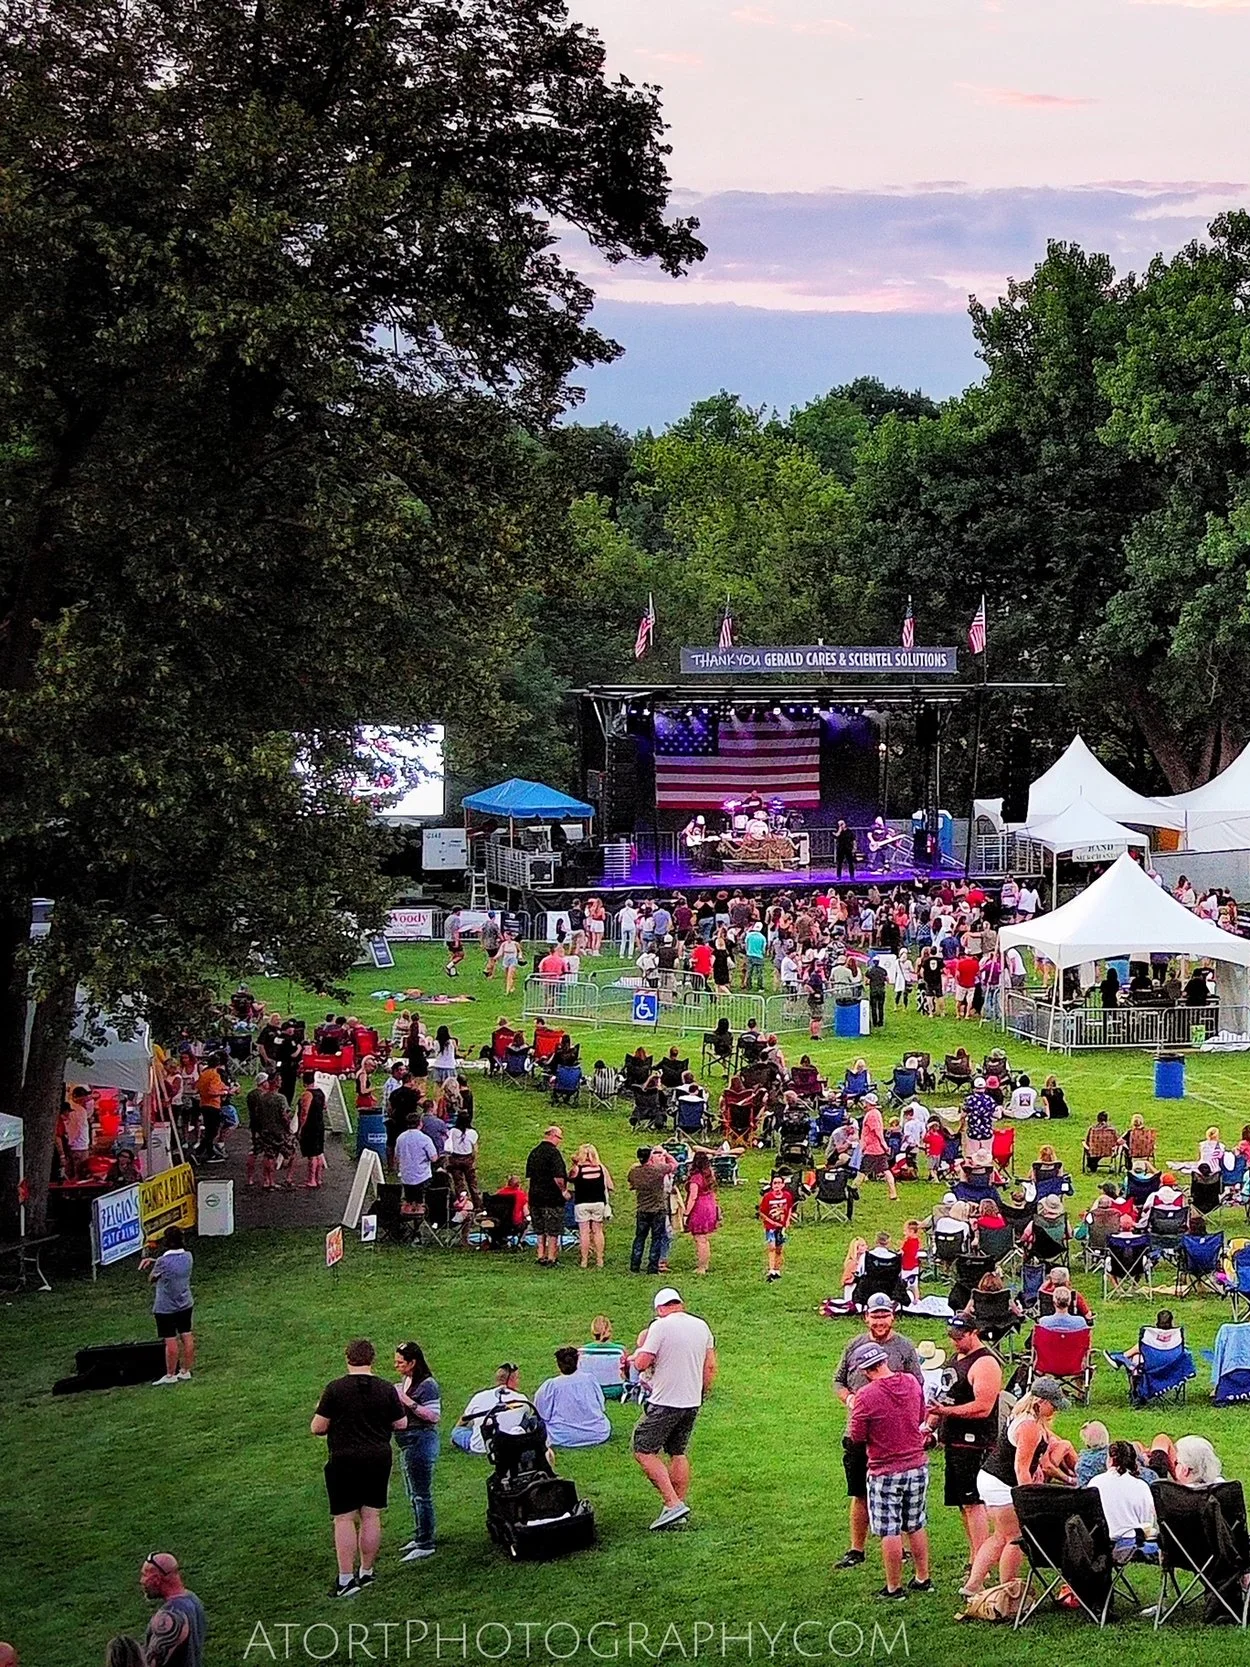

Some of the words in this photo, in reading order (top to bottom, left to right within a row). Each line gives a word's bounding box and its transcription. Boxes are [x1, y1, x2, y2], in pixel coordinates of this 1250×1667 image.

[691, 653, 735, 667] THANK
[735, 653, 761, 667] YOU
[764, 652, 803, 667] GERALD
[806, 652, 837, 667] CARES
[838, 652, 847, 667] &
[848, 652, 893, 667] SCIENTEL
[895, 652, 947, 667] SOLUTIONS
[1088, 843, 1114, 852] BAND
